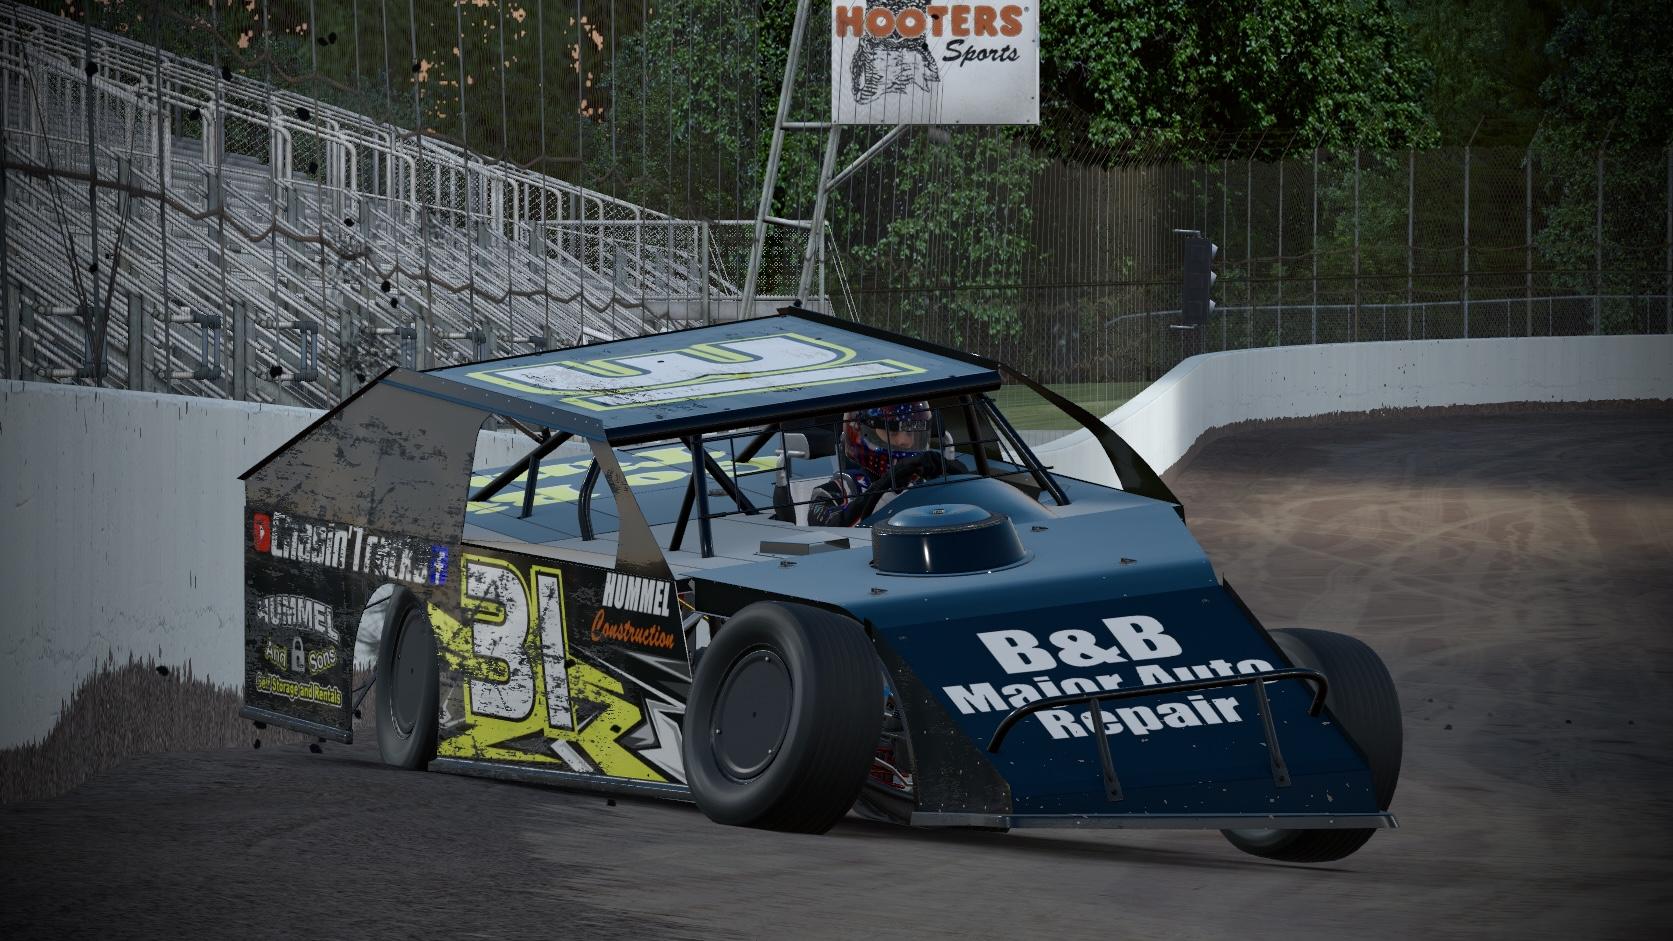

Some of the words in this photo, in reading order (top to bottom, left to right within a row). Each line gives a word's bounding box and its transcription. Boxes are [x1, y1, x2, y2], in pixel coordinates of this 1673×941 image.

[836, 5, 1023, 38] HOOTERS
[942, 39, 1020, 67] Sports
[602, 572, 671, 617] HUMMEL
[257, 594, 341, 645] HUMMEL
[591, 608, 675, 650] Construction
[264, 641, 288, 671] And
[308, 647, 338, 674] Sons
[462, 554, 577, 733] 31
[976, 615, 1183, 675] B&B
[271, 678, 299, 698] Storage
[299, 684, 313, 698] and
[314, 684, 342, 705] Rentals
[942, 673, 1124, 715] Major
[1034, 694, 1243, 740] Repair
